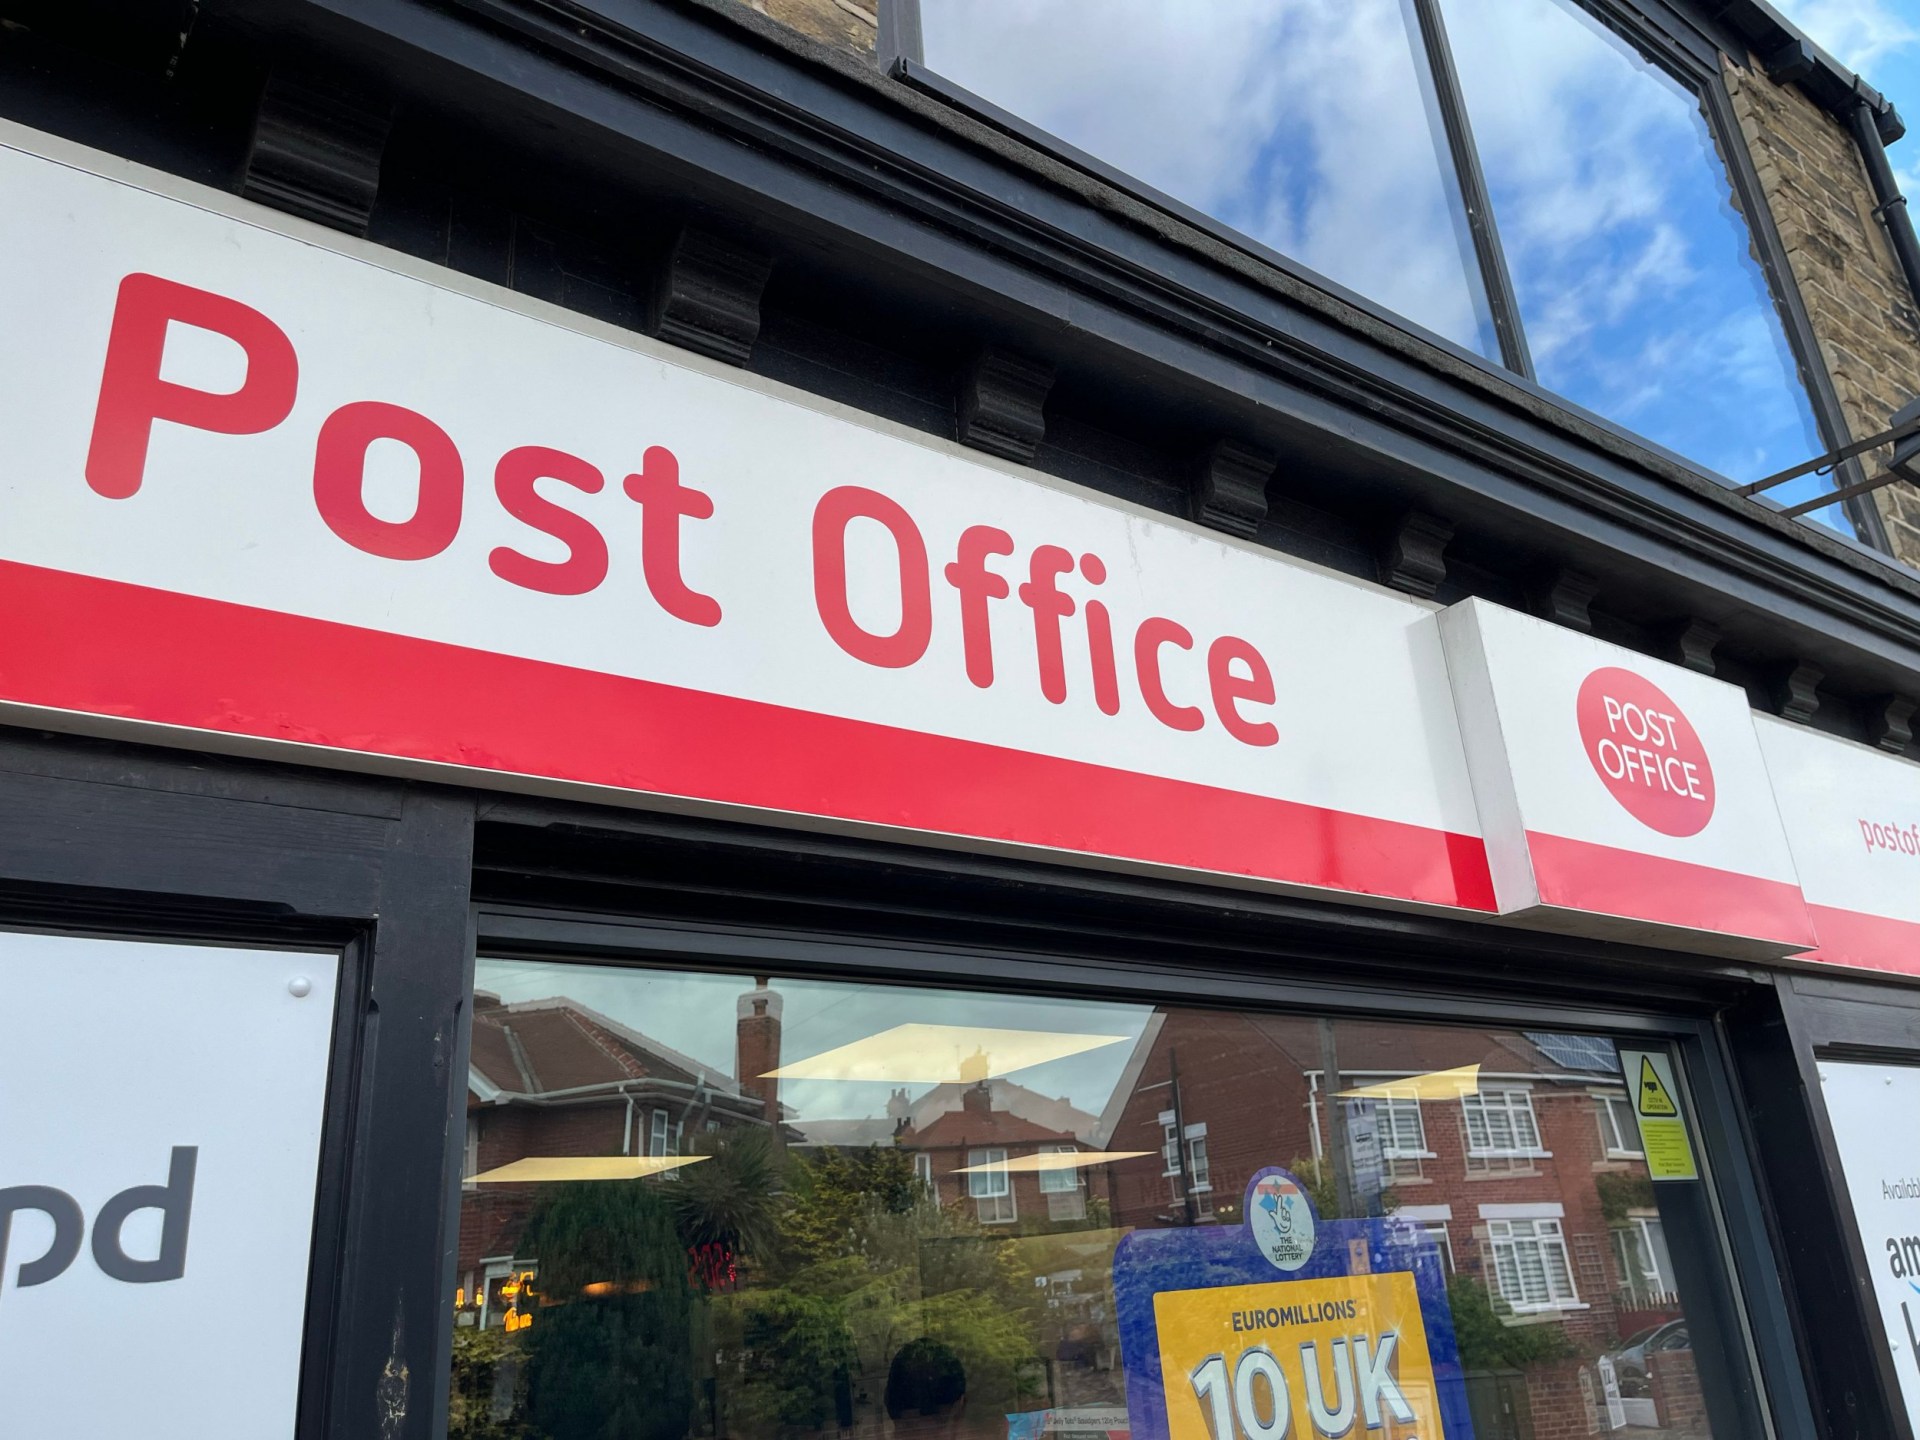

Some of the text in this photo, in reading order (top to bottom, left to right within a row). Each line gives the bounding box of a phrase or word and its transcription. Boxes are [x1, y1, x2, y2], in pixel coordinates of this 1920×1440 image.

[85, 272, 1280, 747] Post Office
[1602, 695, 1678, 751] POST
[1598, 738, 1706, 801] OFFICE
[1272, 1244, 1303, 1253] NATIONAL
[1275, 1252, 1302, 1261] LOTTERY
[1232, 1300, 1357, 1332] EUROMILLIONS
[1189, 1330, 1415, 1440] 10 UK
